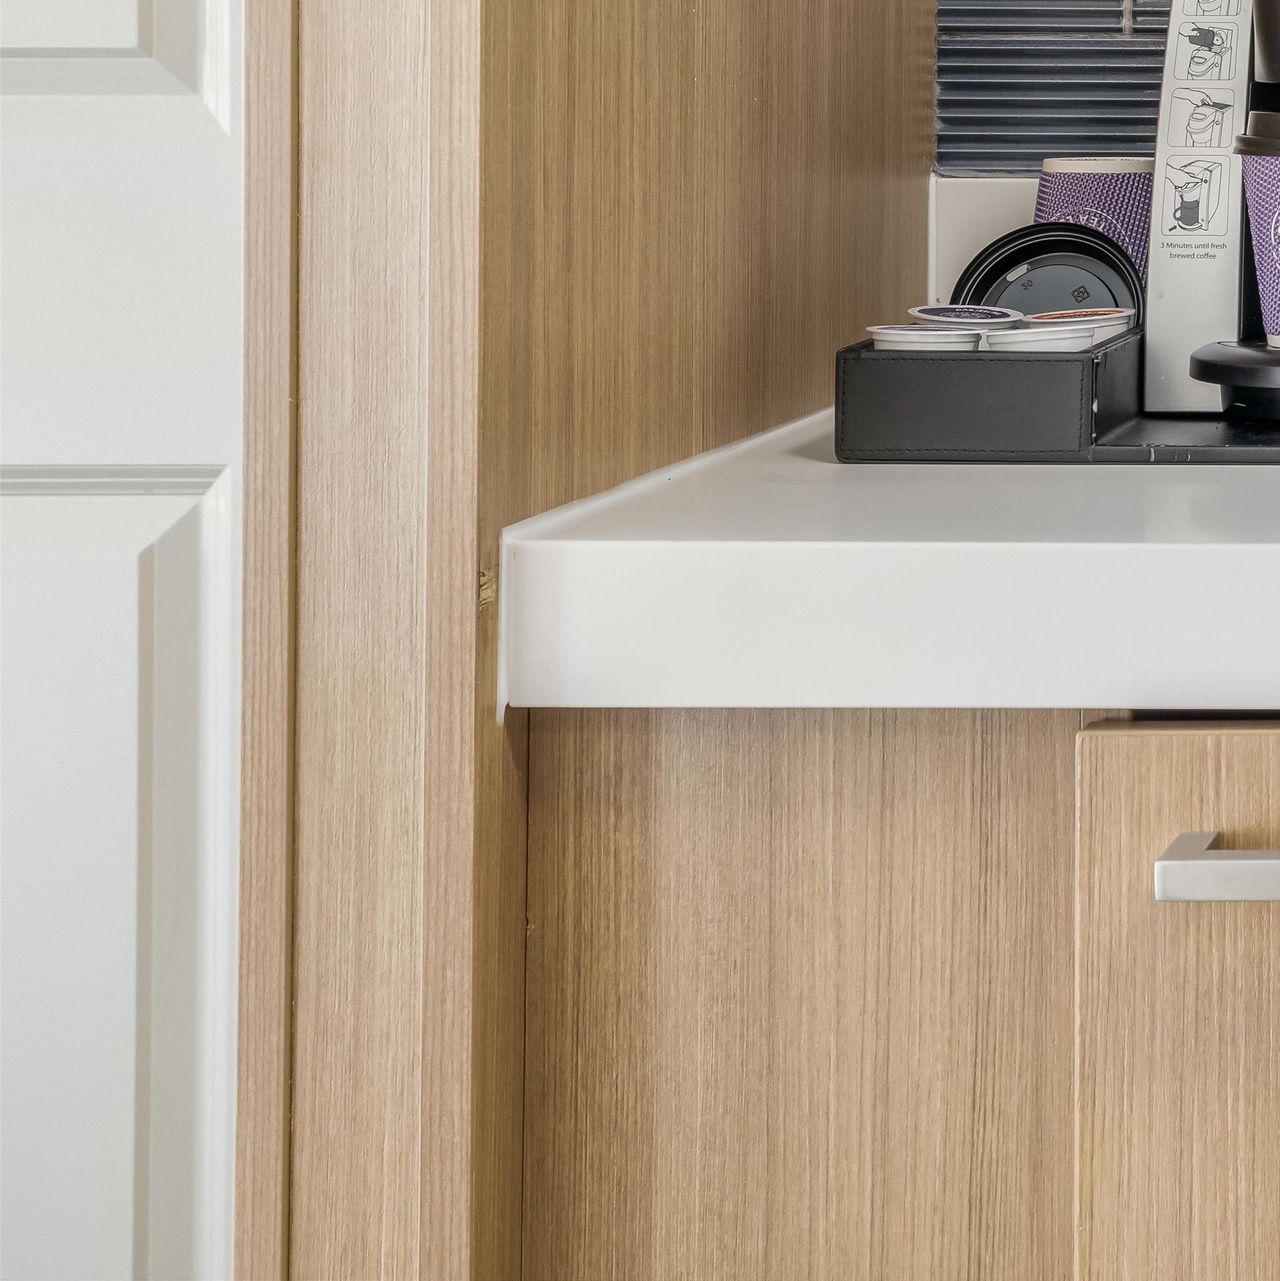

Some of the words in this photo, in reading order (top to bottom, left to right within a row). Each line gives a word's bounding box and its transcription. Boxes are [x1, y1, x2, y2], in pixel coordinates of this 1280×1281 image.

[1165, 241, 1193, 249] Minutes
[1194, 241, 1210, 249] until
[1210, 241, 1228, 249] fresh
[1169, 252, 1195, 260] brewed
[1195, 252, 1217, 260] coffee
